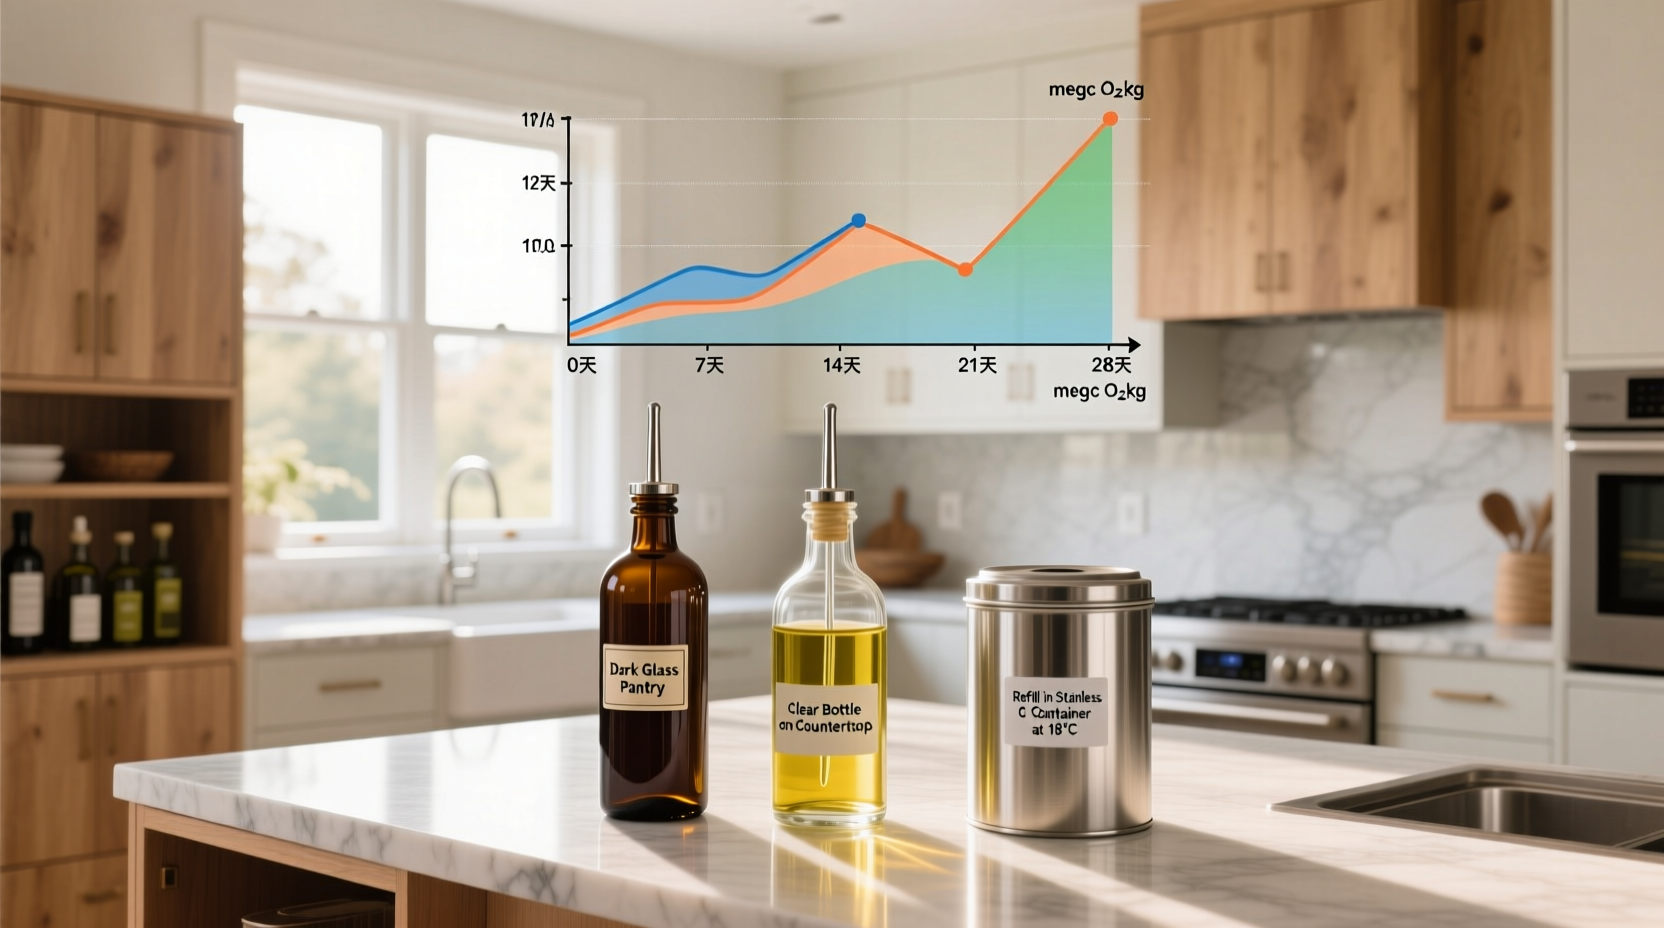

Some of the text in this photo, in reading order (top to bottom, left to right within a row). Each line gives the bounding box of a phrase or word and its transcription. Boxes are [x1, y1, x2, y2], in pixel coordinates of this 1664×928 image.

[609, 661, 679, 677] Dark Glass
[620, 680, 666, 698] Pantry
[787, 701, 862, 716] Clear Bottle
[1032, 724, 1044, 736] at
